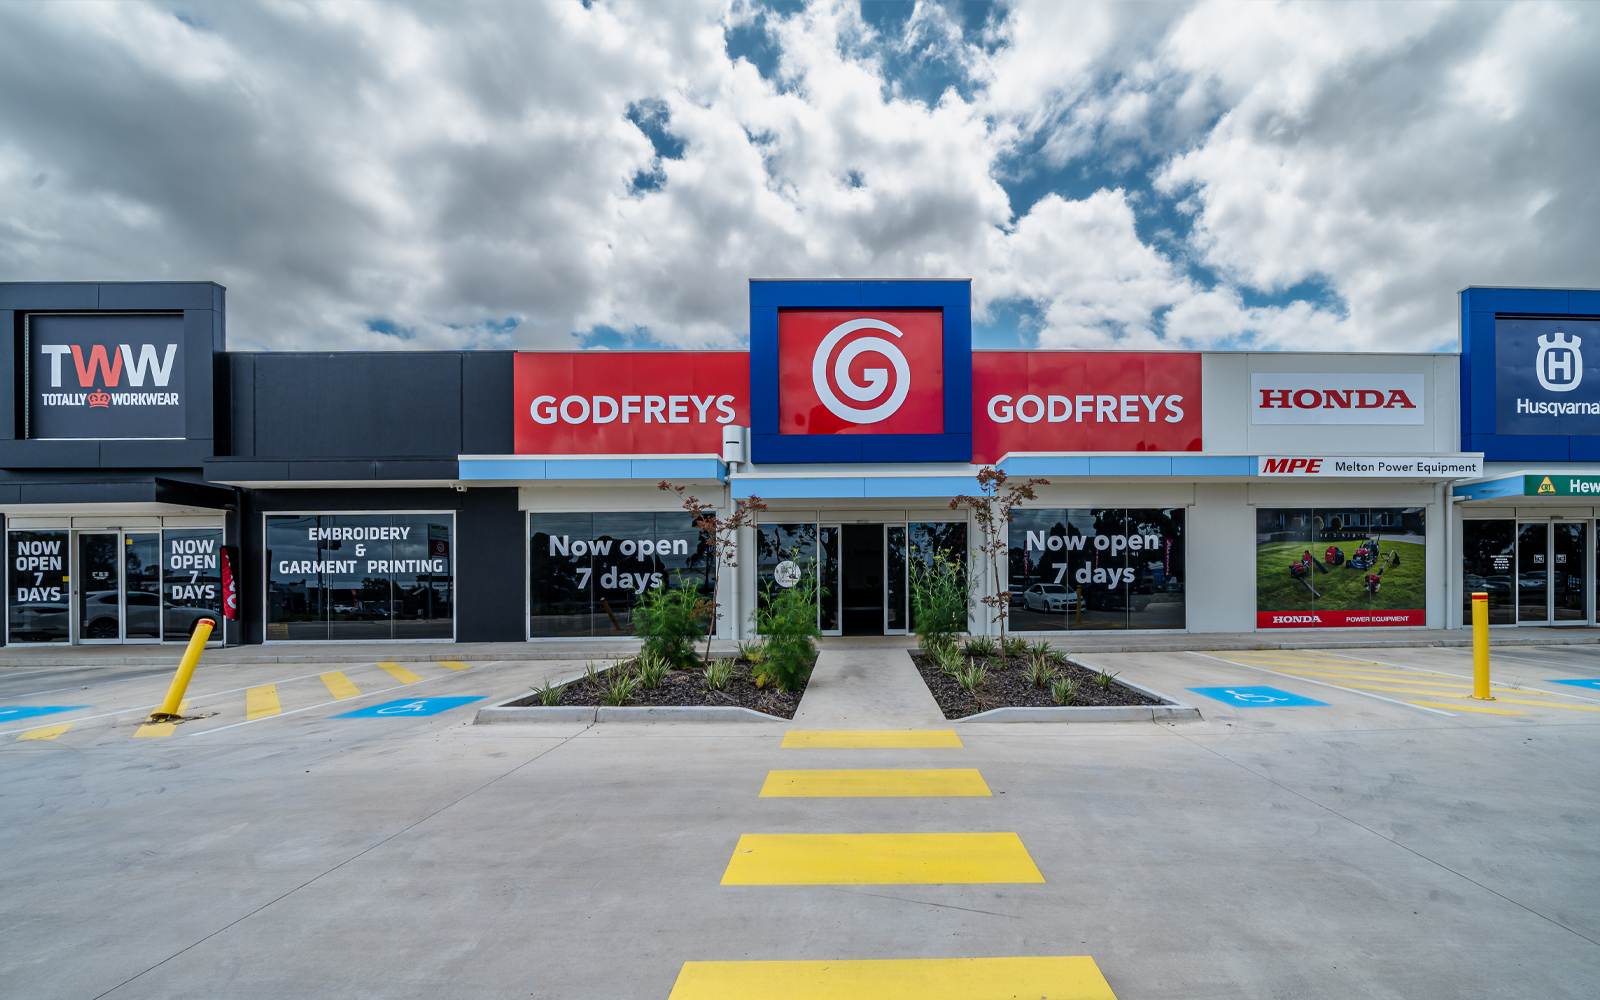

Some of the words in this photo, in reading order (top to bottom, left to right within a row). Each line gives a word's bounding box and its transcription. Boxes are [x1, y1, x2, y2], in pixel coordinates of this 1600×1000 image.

[41, 343, 178, 388] TWW
[42, 393, 87, 406] TOTALLY
[111, 393, 179, 406] WORKWEAR
[1259, 389, 1416, 409] HONDA
[530, 395, 736, 424] GODFREYS
[987, 394, 1184, 423] GODFREYS
[1517, 398, 1600, 417] Husqvarna
[1262, 458, 1324, 474] MPE
[1335, 461, 1375, 472] Melton
[1378, 462, 1414, 472] Power
[1417, 461, 1476, 475] Equipment
[308, 527, 411, 541] EMBROIDERY
[18, 540, 61, 556] NOW
[172, 540, 215, 554] NOW
[355, 544, 367, 557] &
[549, 535, 613, 557] Now
[619, 538, 688, 562] open
[1026, 530, 1087, 551] Now
[1093, 533, 1159, 557] open
[16, 556, 62, 571] OPEN
[170, 555, 216, 569] OPEN
[279, 560, 358, 574] GARMENT
[367, 559, 443, 574] PRINTING
[33, 572, 44, 586] 7
[189, 570, 199, 584] 7
[576, 567, 592, 589] 7
[600, 565, 664, 595] days
[1051, 562, 1067, 584] 7
[1075, 561, 1135, 590] days
[17, 587, 61, 602] DAYS
[172, 585, 215, 600] DAYS
[1272, 615, 1323, 624] HONDA
